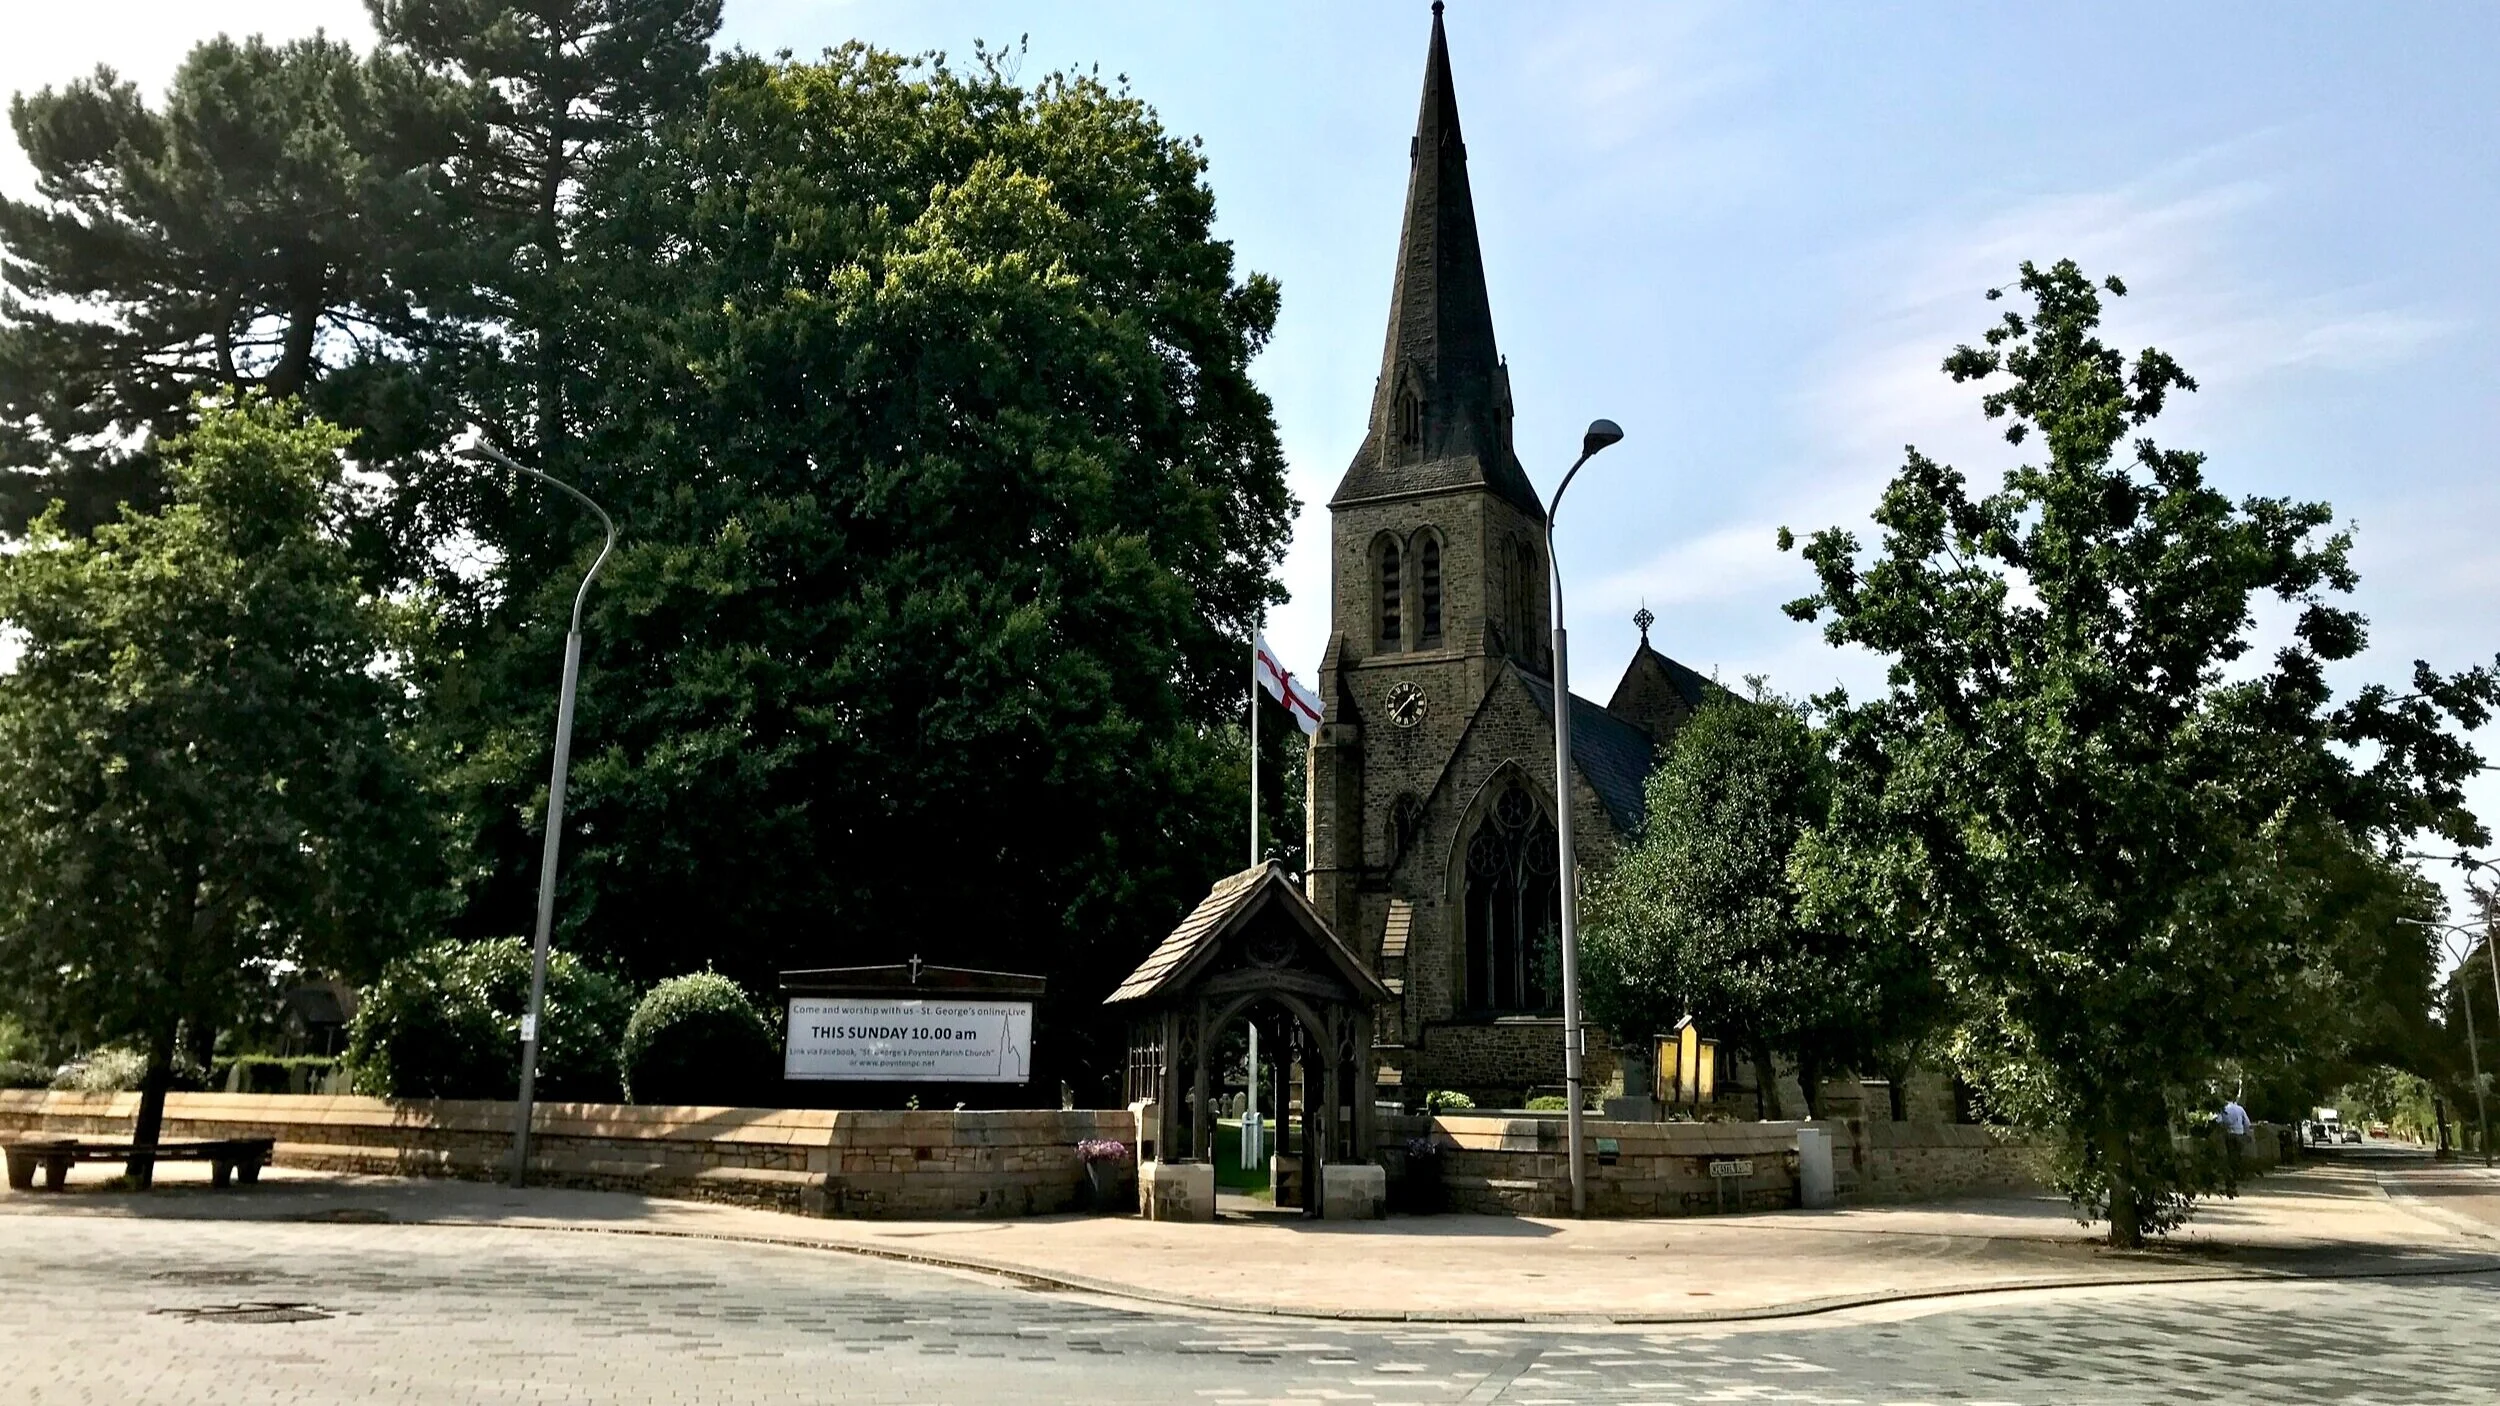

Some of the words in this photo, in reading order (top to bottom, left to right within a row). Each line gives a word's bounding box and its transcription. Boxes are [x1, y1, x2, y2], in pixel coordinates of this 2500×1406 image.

[793, 1005, 820, 1014] Come
[822, 1006, 839, 1015] and
[841, 1005, 879, 1016] worship
[880, 1006, 901, 1015] with
[903, 1008, 914, 1016] us
[920, 1007, 933, 1016] St.
[935, 1007, 976, 1017] George's
[977, 1007, 1006, 1017] online
[1008, 1008, 1026, 1017] Live
[811, 1026, 845, 1039] THIS
[848, 1026, 908, 1039] SUNDAY
[911, 1027, 952, 1041] 10.00
[955, 1030, 977, 1041] am
